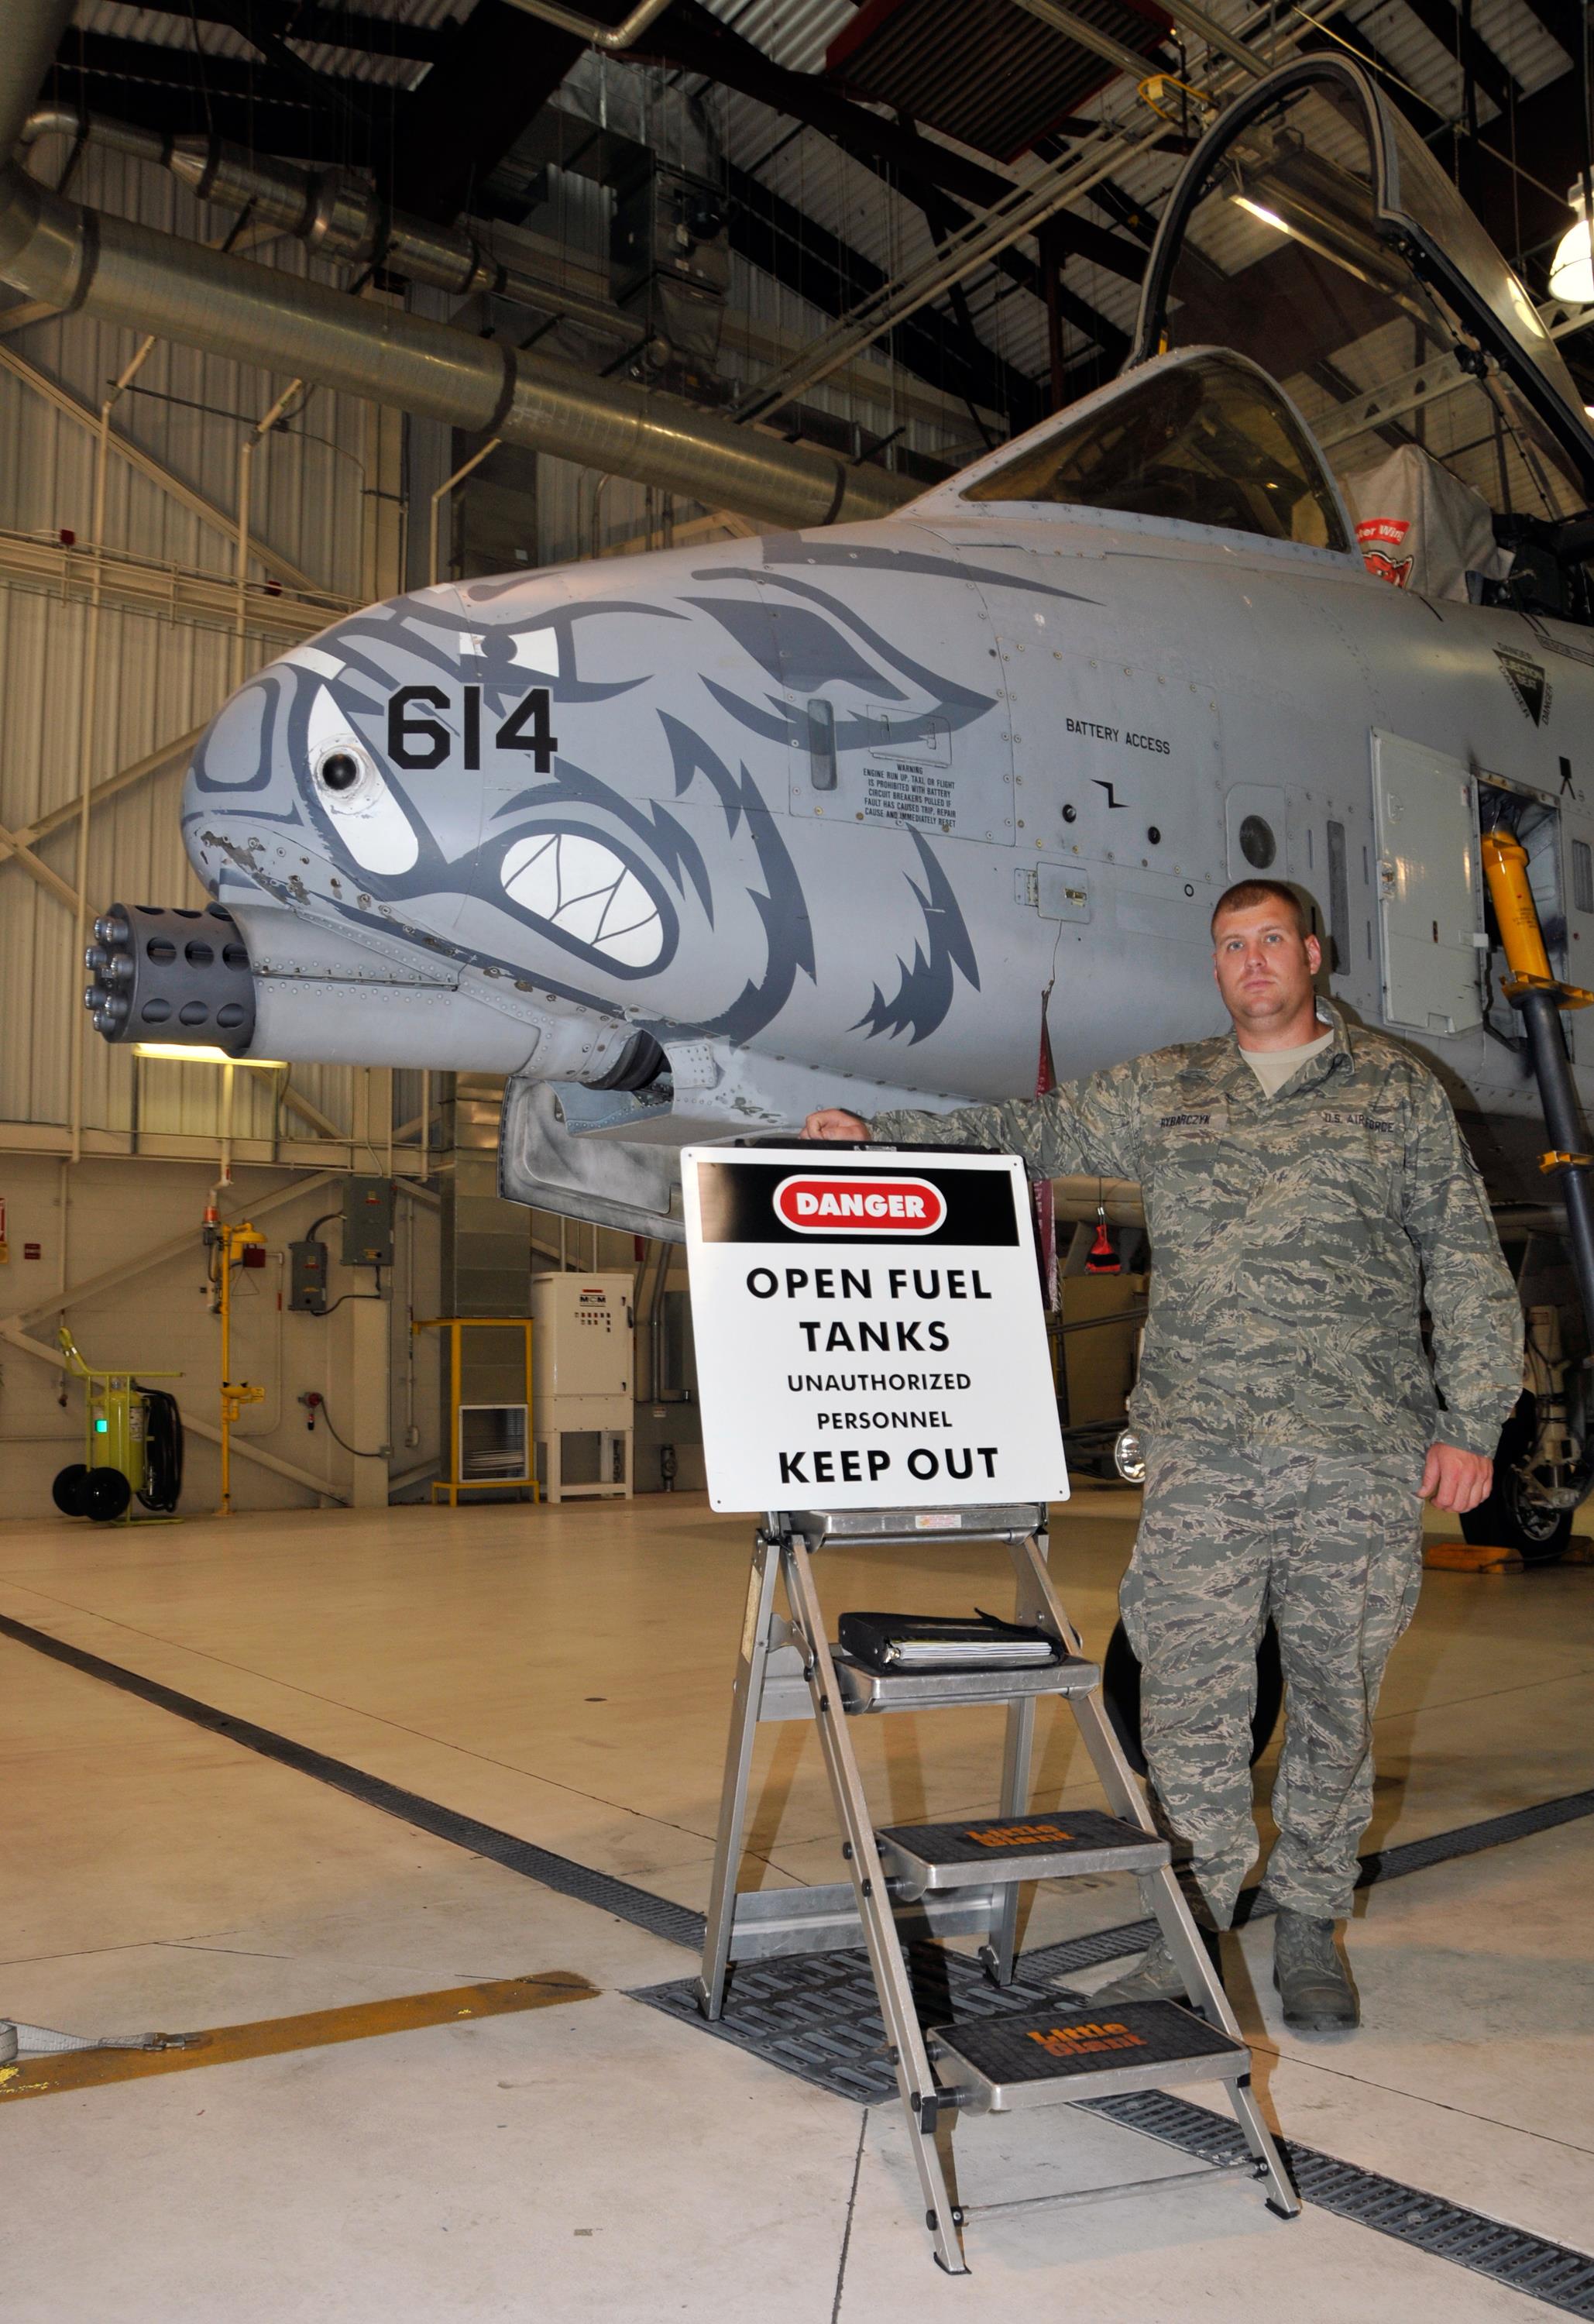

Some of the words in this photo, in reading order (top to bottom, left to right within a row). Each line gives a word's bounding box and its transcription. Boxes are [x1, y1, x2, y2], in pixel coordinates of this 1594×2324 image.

[1357, 528, 1376, 538] ter
[387, 686, 558, 774] 614
[1066, 717, 1119, 743] BATTERY
[1125, 731, 1171, 755] ACCESS
[863, 768, 885, 779] ENGINE
[886, 772, 898, 780] RUN
[936, 779, 955, 789] FLIGHT
[897, 763, 923, 775] WARNING
[868, 779, 874, 787] IS
[877, 780, 909, 792] PROHIBITED
[912, 785, 926, 794] WITH
[927, 787, 951, 798] BATTERY
[868, 788, 891, 798] CIRCUIT
[893, 792, 922, 803] BREAKERS
[924, 797, 944, 807] PULLED
[864, 797, 881, 807] FAULT
[883, 800, 895, 809] HAS
[897, 803, 919, 813] CAUSED
[936, 808, 957, 819] REPAIR
[864, 807, 884, 817] CAUSE
[900, 812, 936, 826] IMMEDIATELY
[938, 818, 956, 828] RESET
[1347, 1114, 1366, 1125] AIR
[1365, 1117, 1395, 1133] FORCE
[795, 1191, 927, 1219] DANGER
[746, 1267, 873, 1299] OPEN
[888, 1269, 992, 1300] FUEL
[799, 1321, 950, 1352] TANKS
[788, 1373, 971, 1392] UNAUTHORIZED
[817, 1411, 953, 1430] PERSONNEL
[778, 1449, 891, 1484] KEEP
[907, 1447, 998, 1480] OUT
